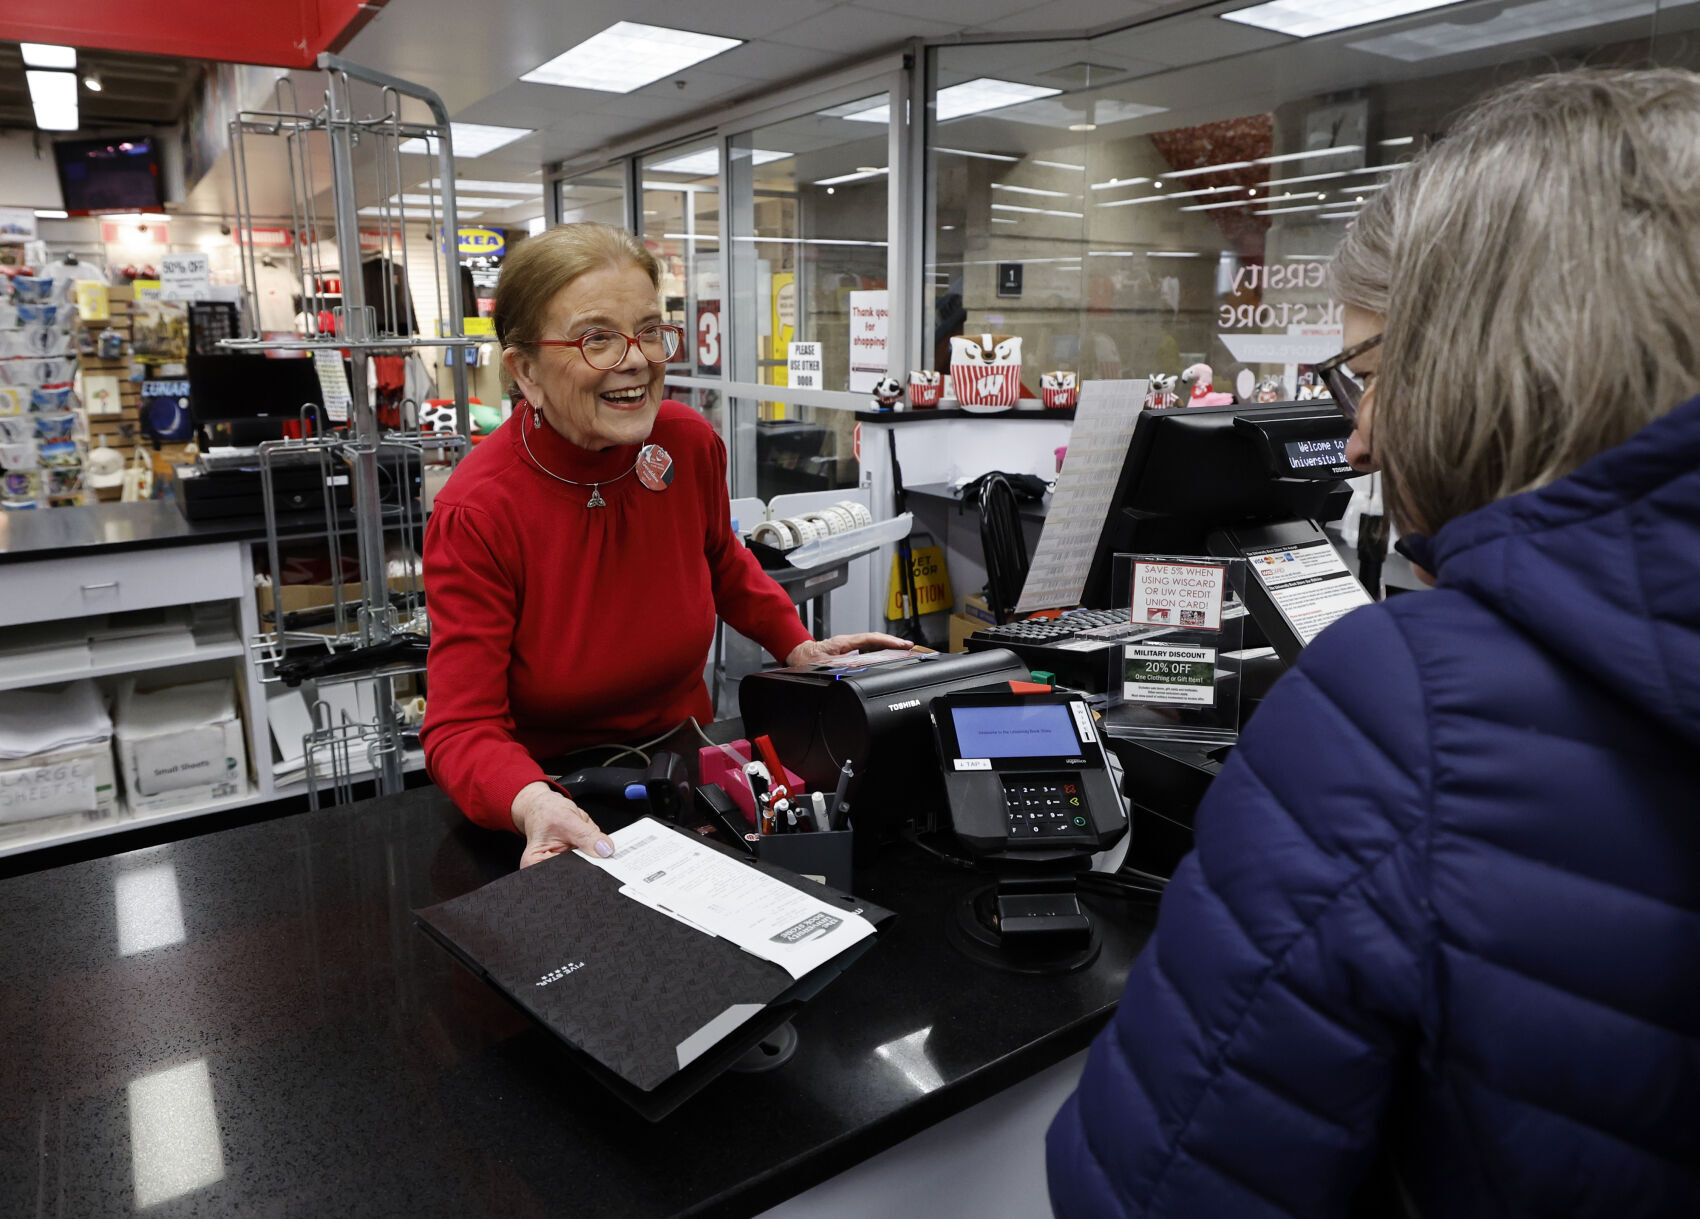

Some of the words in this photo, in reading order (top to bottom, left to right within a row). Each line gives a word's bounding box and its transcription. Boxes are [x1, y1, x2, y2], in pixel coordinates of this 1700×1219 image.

[458, 235, 499, 245] KEA
[1009, 269, 1014, 281] 1
[852, 306, 874, 317] Thank
[875, 309, 889, 320] you
[864, 322, 875, 331] for
[795, 344, 816, 356] PLEASE
[790, 359, 801, 371] USE
[802, 359, 820, 371] OTHER
[797, 375, 813, 386] DOOR
[977, 374, 1004, 398] W
[1297, 441, 1331, 452] Welcome
[1334, 440, 1345, 449] to
[1288, 454, 1337, 468] University
[912, 565, 937, 577] OOR
[1144, 565, 1169, 574] SAVE
[1170, 566, 1184, 575] 5%
[1186, 568, 1214, 576] WHEN
[1141, 576, 1170, 585] USING
[1172, 578, 1216, 588] WISCARD
[895, 582, 945, 608] CTION
[1144, 587, 1159, 595] OR
[1161, 588, 1176, 596] UW
[1178, 589, 1211, 598] CREDIT
[1145, 598, 1176, 607] UNION
[1178, 600, 1209, 609] CARD!
[1133, 649, 1168, 657] MILITARY
[1168, 651, 1206, 659] DISCOUNT
[1145, 661, 1169, 673] 20%
[1171, 663, 1192, 674] OFF
[1147, 674, 1170, 682] Clothing
[1177, 675, 1188, 683] Gift
[888, 699, 921, 711] TOSHIBA
[154, 765, 179, 776] Small
[180, 760, 210, 770] Sheets
[0, 765, 81, 787] LARGE
